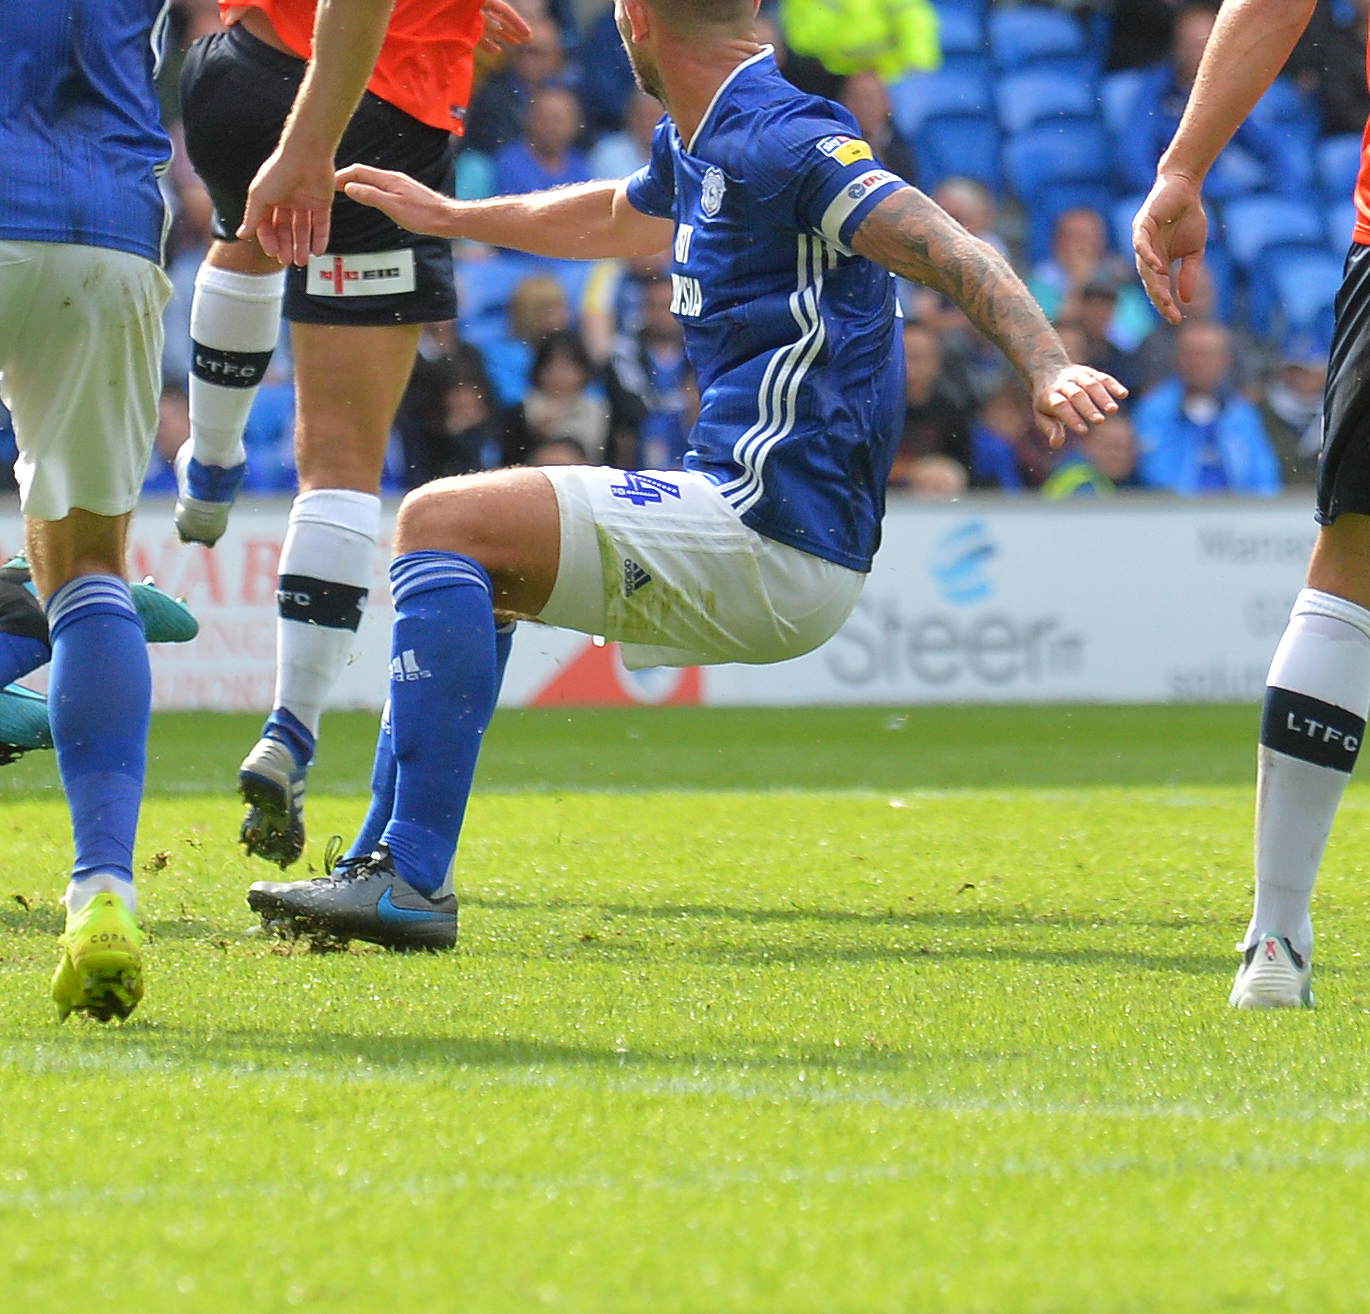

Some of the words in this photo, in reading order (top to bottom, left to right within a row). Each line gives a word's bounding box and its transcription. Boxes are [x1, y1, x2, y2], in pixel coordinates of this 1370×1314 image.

[195, 353, 257, 379] LTFC
[610, 471, 682, 507] 4
[825, 591, 1058, 685] Steer
[1287, 711, 1359, 753] LTFC
